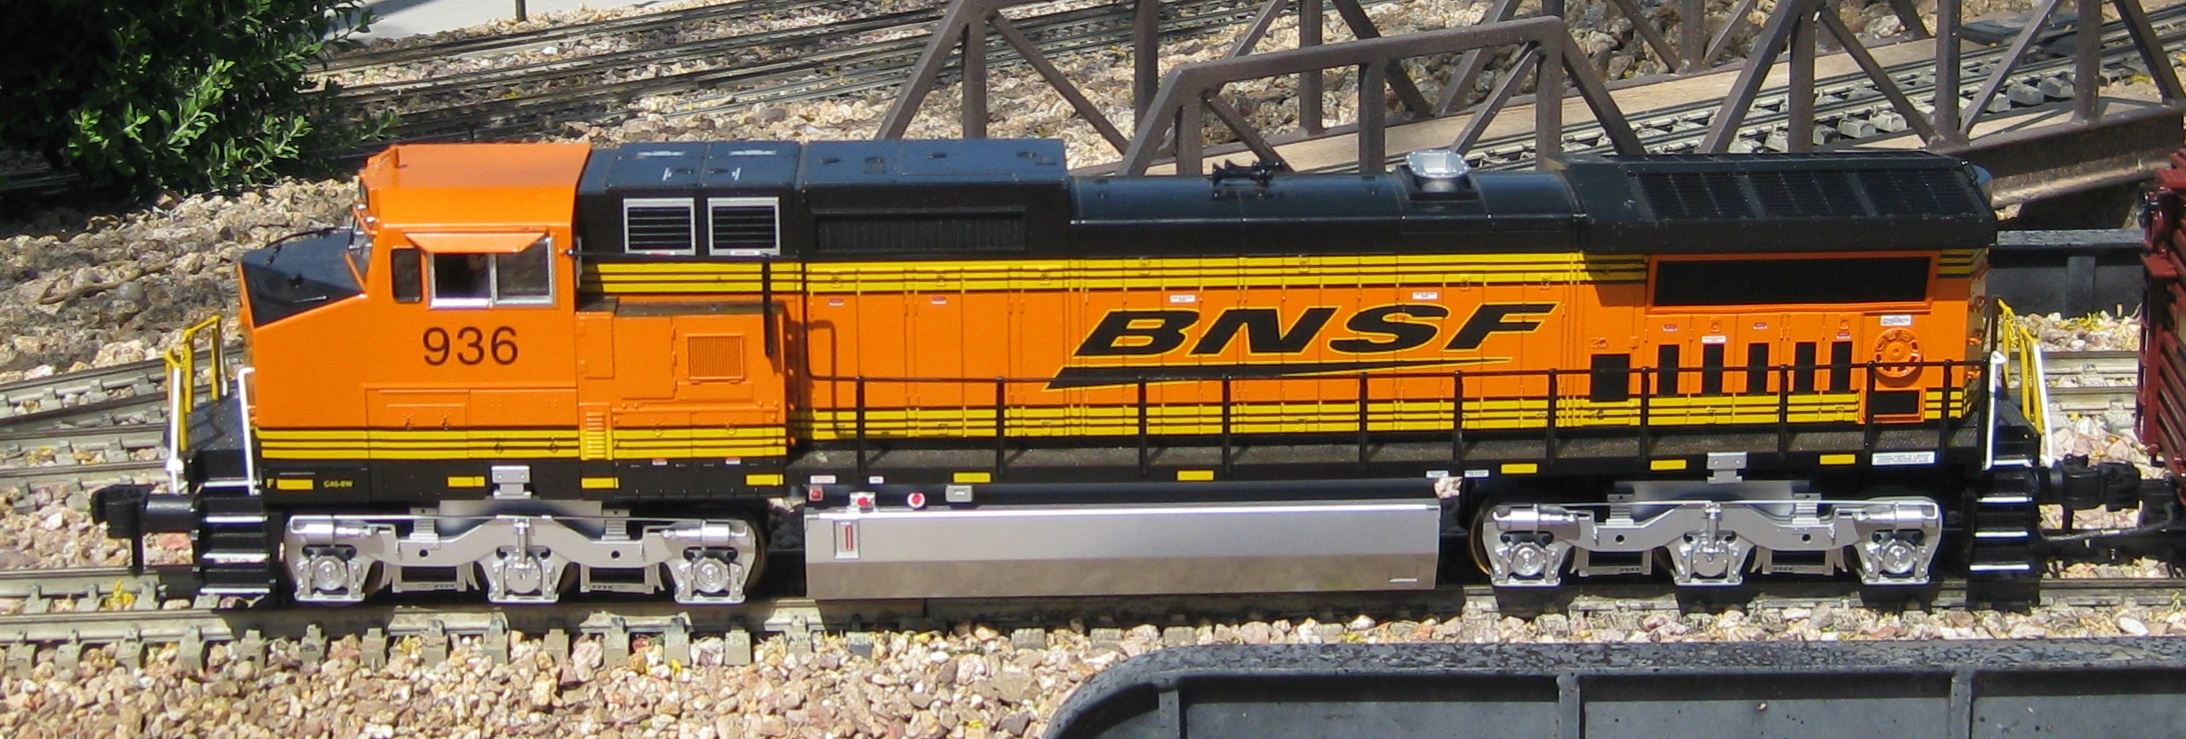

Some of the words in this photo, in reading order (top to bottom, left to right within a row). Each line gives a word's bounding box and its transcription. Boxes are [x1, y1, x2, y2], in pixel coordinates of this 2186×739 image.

[422, 326, 519, 366] 936
[1073, 303, 1559, 357] BNSF
[266, 478, 275, 488] F
